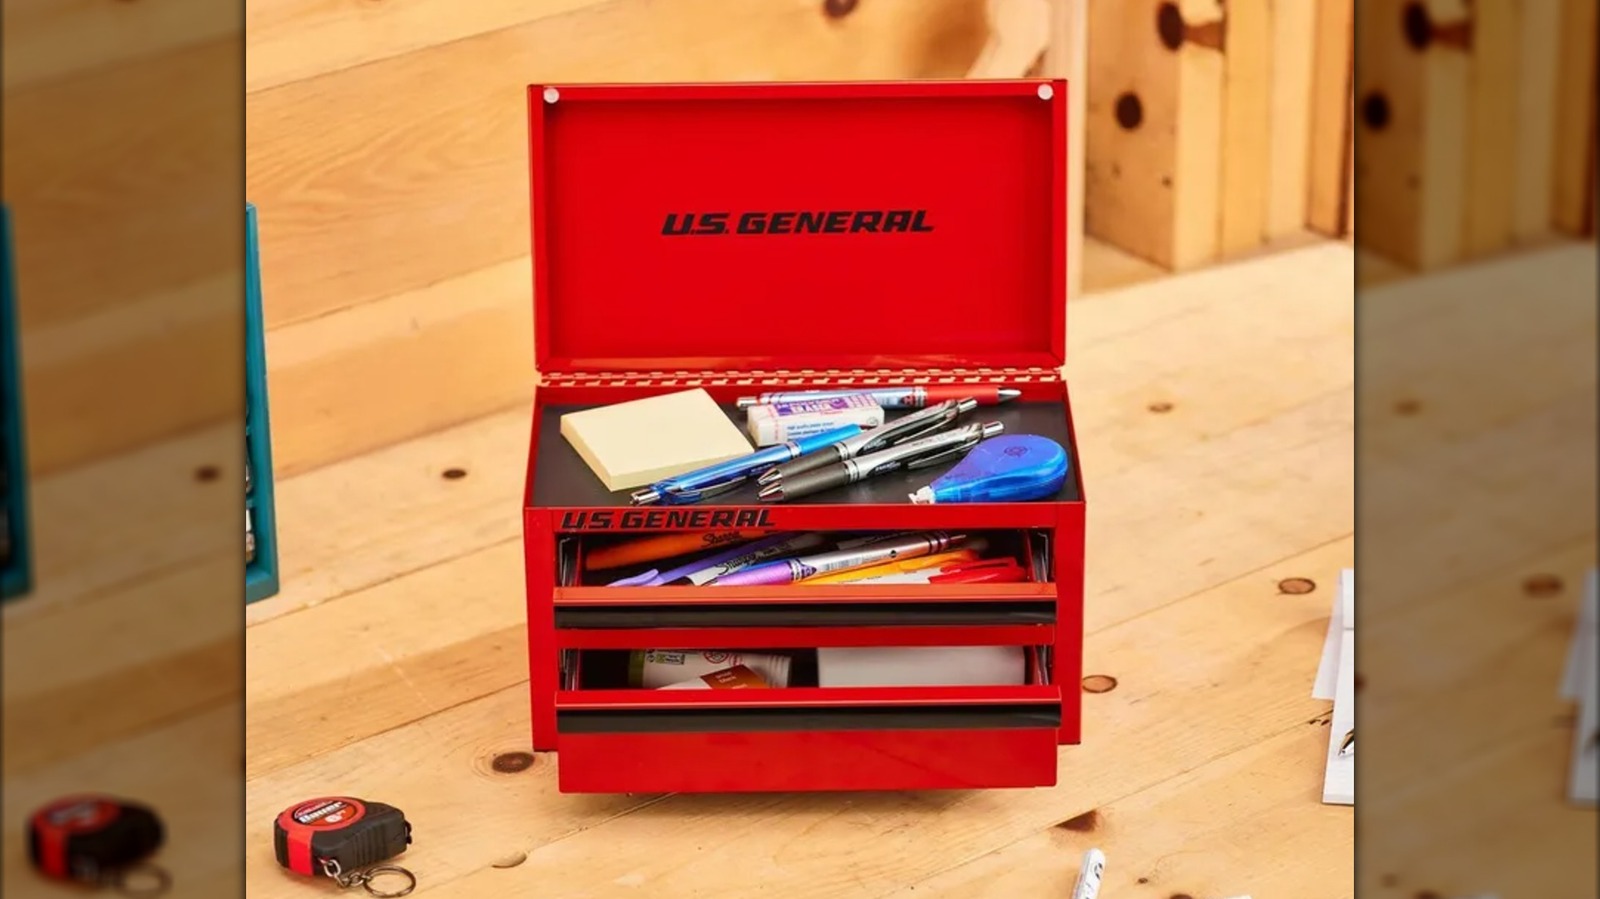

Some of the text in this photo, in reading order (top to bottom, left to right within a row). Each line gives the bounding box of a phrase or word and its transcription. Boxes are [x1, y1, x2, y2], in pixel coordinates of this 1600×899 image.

[661, 210, 934, 236] U.S. GENERAL
[562, 509, 775, 529] U.S. GENERAL
